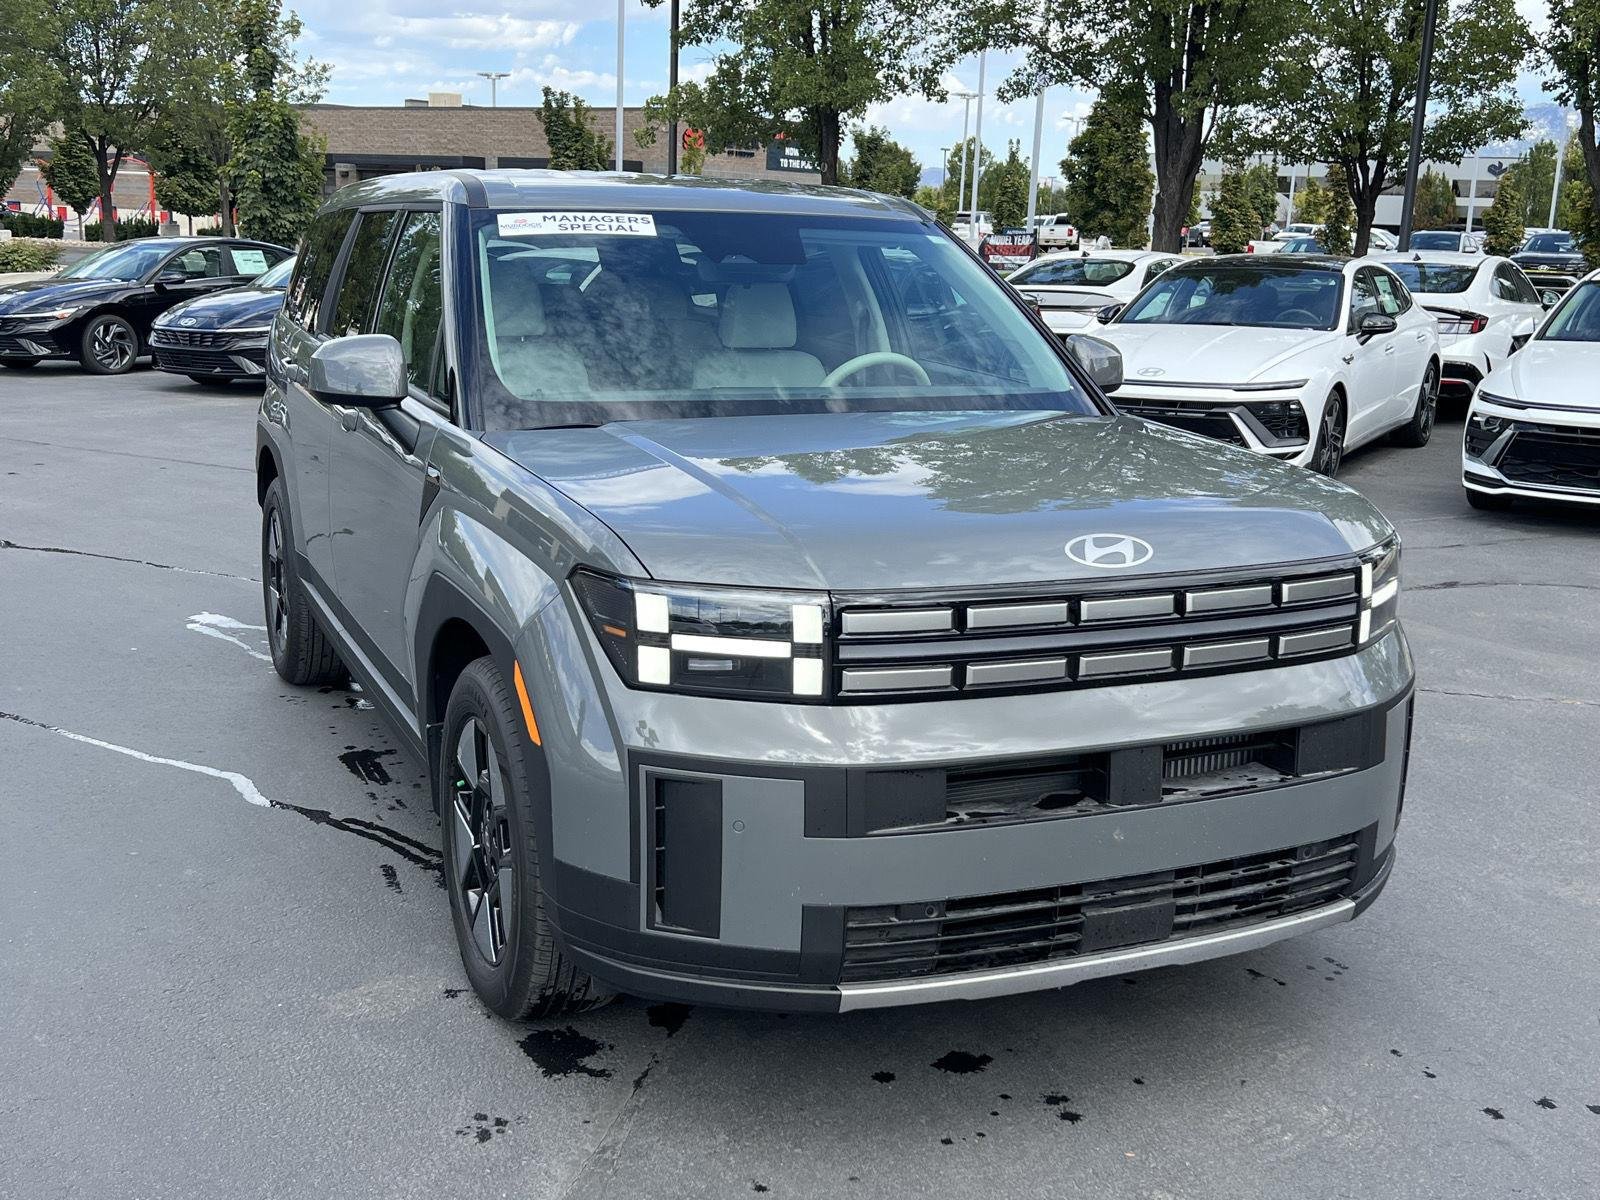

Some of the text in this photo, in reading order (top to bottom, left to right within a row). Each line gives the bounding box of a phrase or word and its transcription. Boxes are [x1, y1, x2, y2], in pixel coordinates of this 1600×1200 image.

[780, 158, 788, 168] TO
[789, 159, 800, 169] THE
[543, 215, 651, 225] MANAGERS
[559, 223, 640, 232] SPECIAL
[989, 235, 1031, 245] MODEL YEAR
